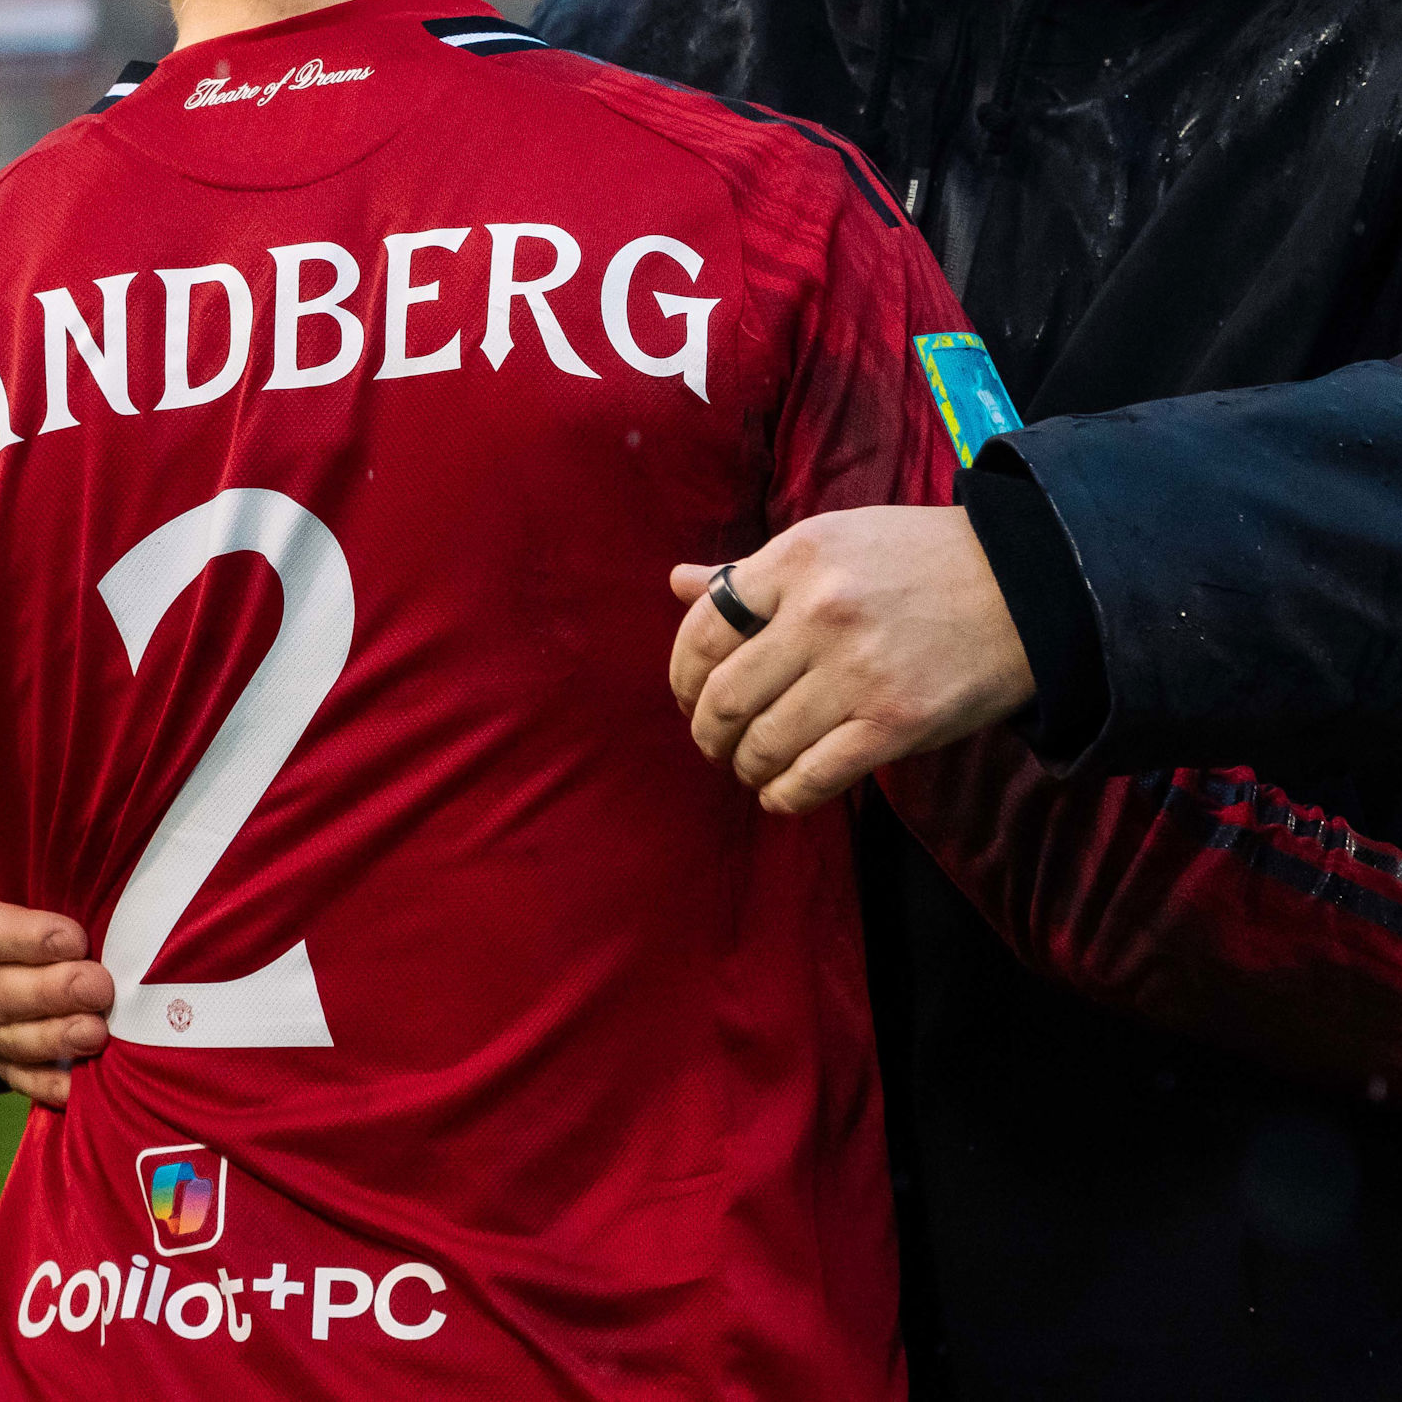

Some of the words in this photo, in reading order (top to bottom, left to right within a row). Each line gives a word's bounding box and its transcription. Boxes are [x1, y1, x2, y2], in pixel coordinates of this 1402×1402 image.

[184, 77, 262, 110] Theatre
[256, 67, 296, 107] of
[288, 58, 375, 90] Dreams
[96, 487, 356, 1048] 2
